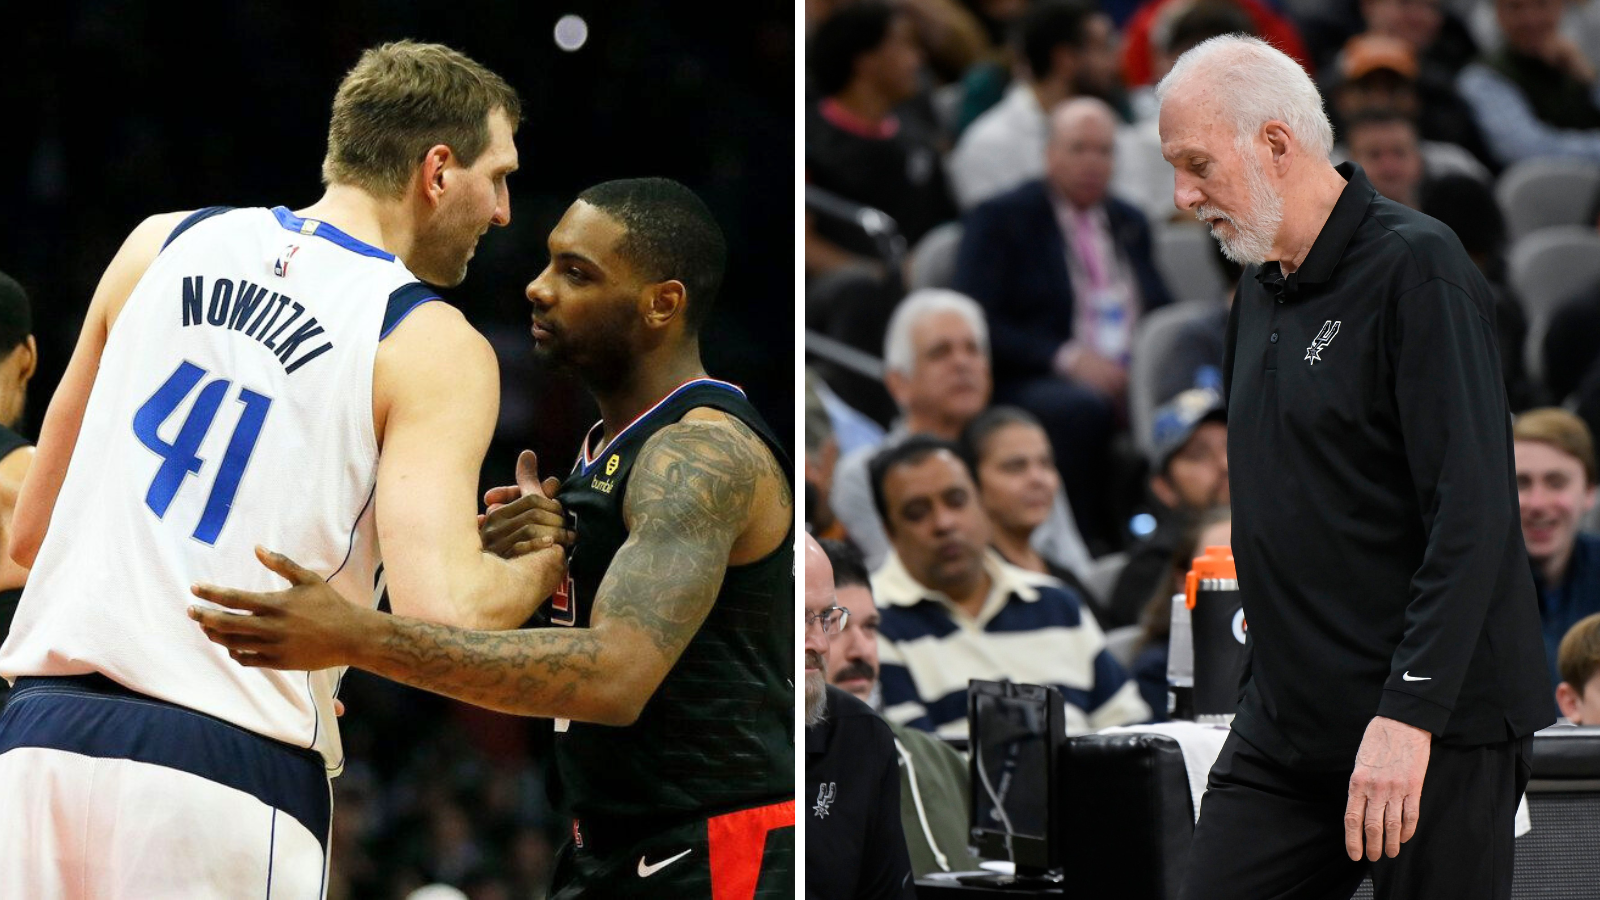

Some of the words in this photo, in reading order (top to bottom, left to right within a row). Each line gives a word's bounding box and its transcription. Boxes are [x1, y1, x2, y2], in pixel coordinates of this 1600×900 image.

[182, 275, 333, 375] NOWITZKI
[132, 359, 273, 547] 41
[591, 474, 614, 494] bumble
